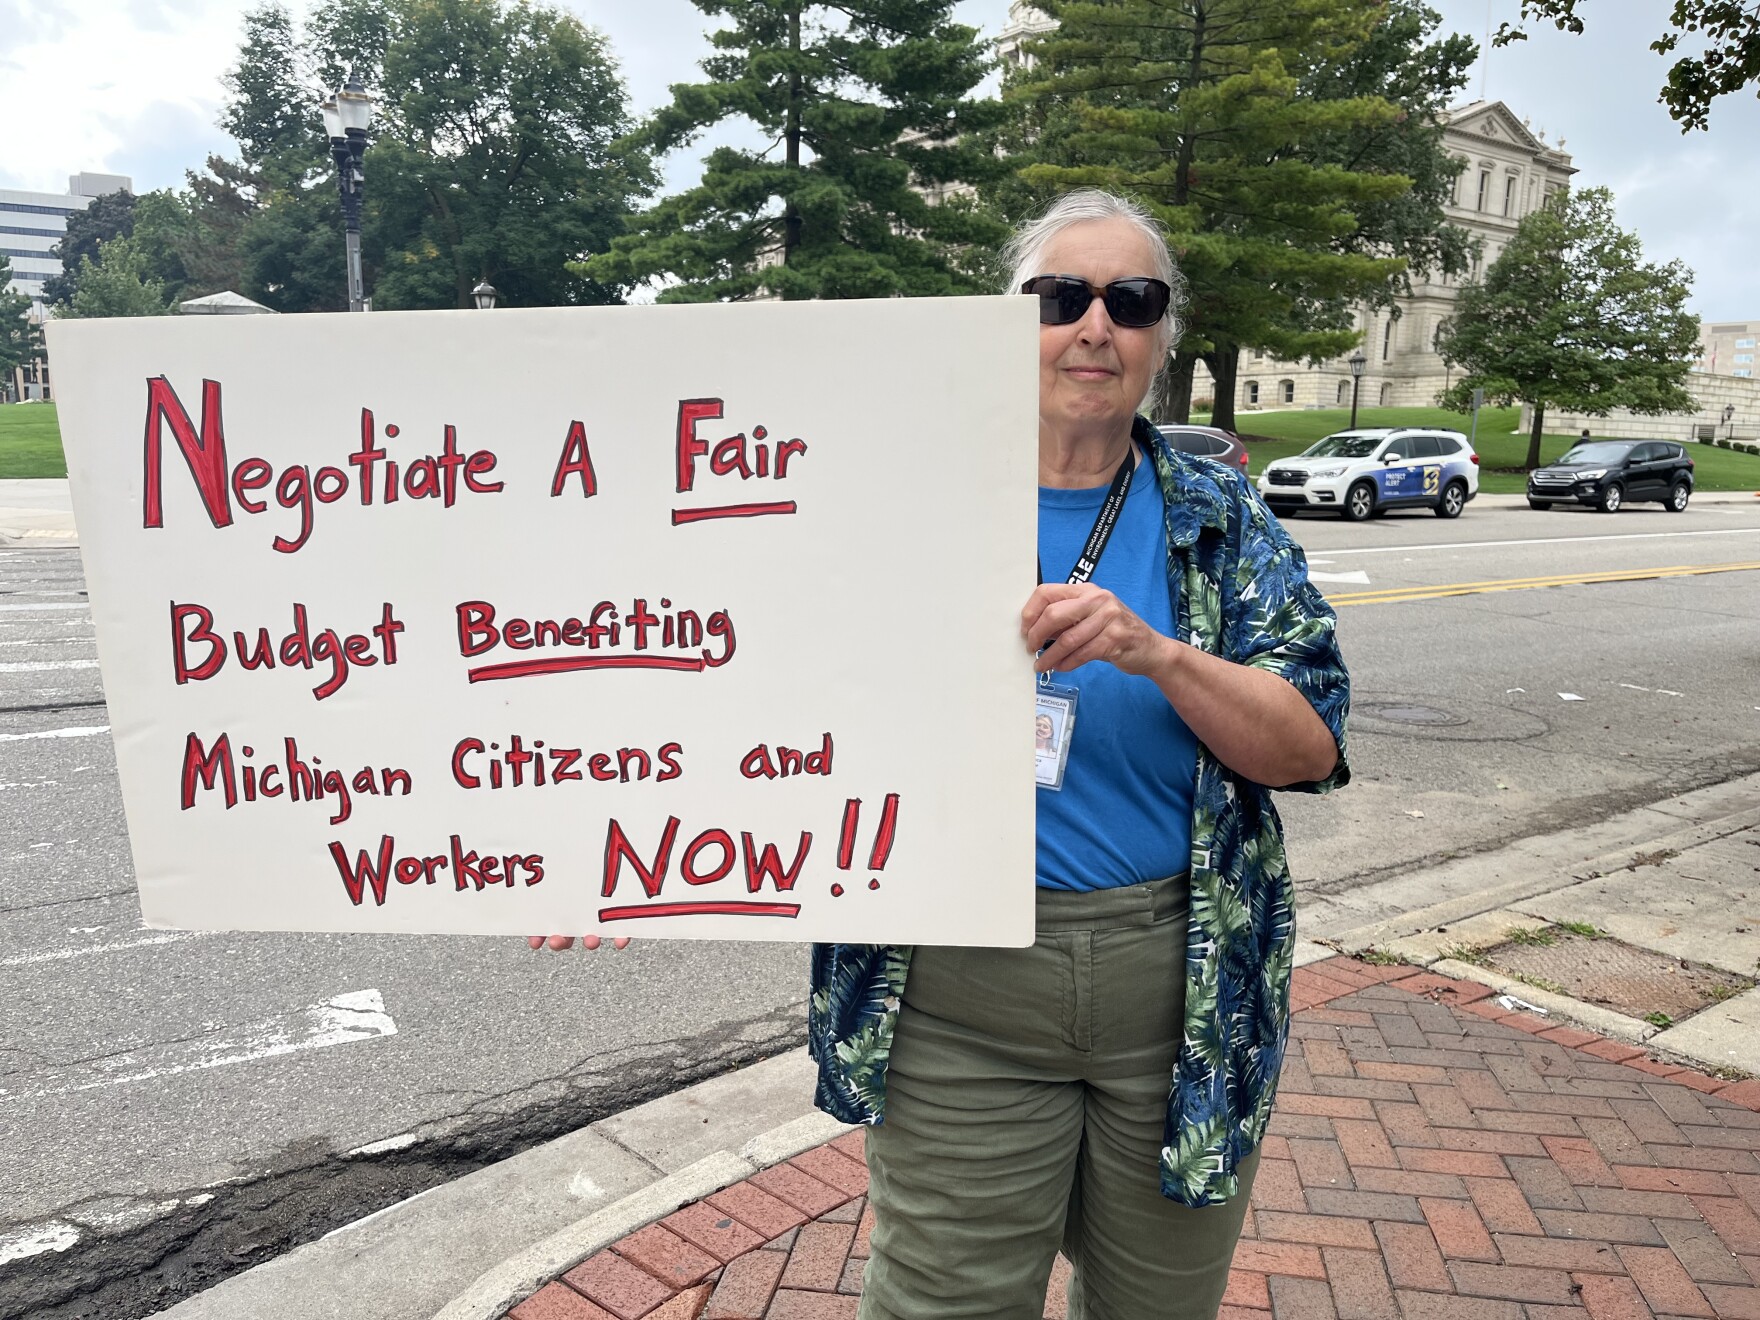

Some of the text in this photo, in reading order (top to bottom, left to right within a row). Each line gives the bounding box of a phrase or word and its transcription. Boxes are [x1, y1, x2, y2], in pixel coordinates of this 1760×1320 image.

[144, 374, 808, 554] Negotiate A Fair
[1086, 495, 1114, 556] MICHIGAN DEPARTMENT OF
[1091, 524, 1111, 559] ENVIRONMENT,
[1107, 509, 1116, 524] GREAT
[1122, 470, 1131, 487] ENERGY
[171, 598, 737, 701] Budget Benefiting
[1041, 698, 1067, 708] MICHIGAN
[181, 731, 834, 826] Michigan Citizens and
[328, 834, 545, 907] Workers
